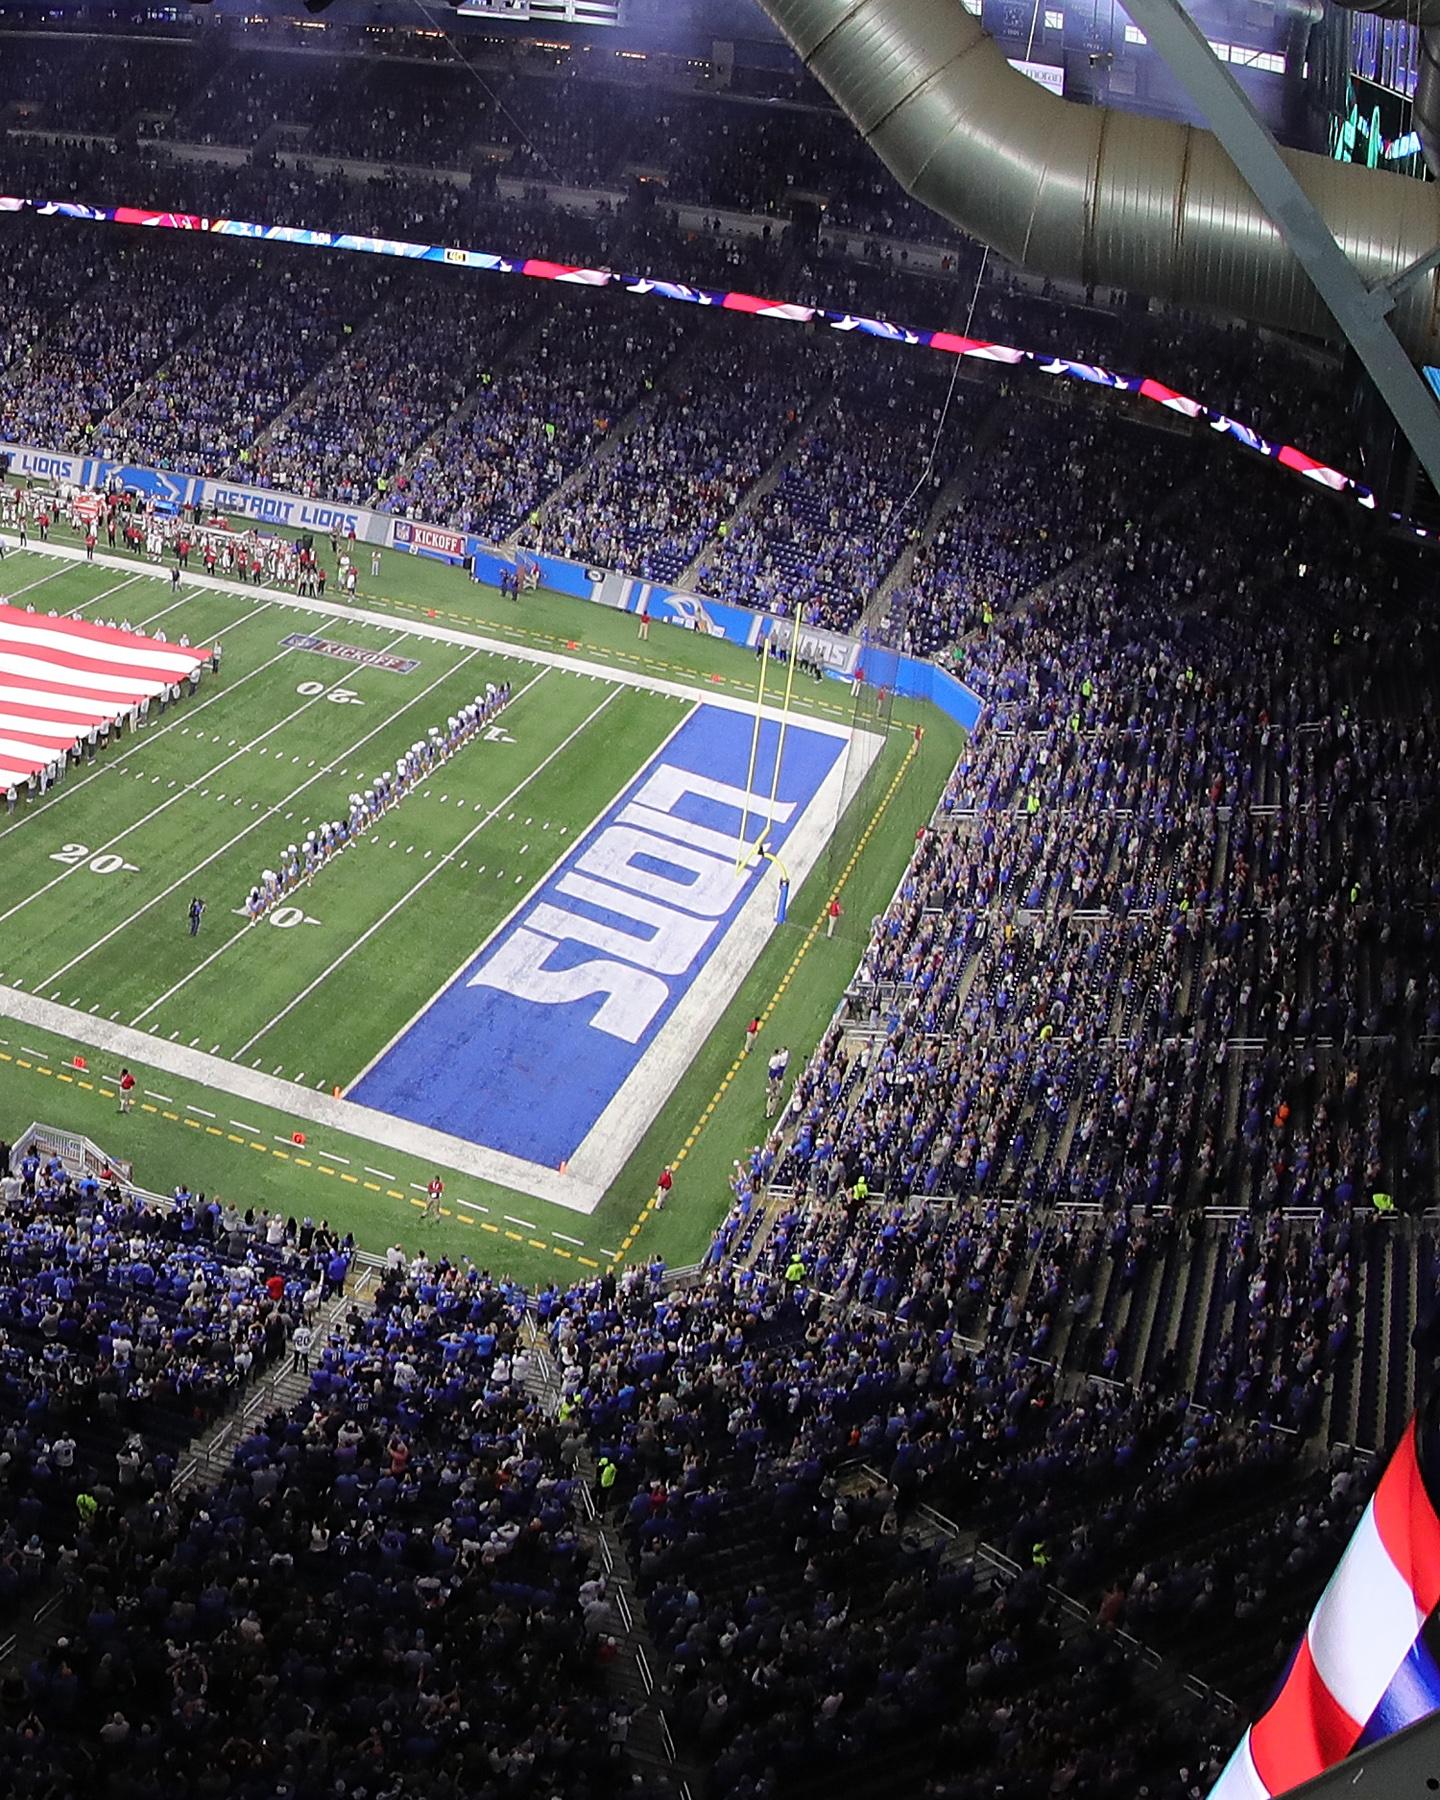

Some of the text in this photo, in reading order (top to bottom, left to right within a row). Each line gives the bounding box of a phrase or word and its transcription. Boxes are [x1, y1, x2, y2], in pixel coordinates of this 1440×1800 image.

[22, 454, 72, 477] LIONS
[214, 489, 358, 532] DETROIT LIONS
[415, 529, 458, 552] KICKOFF
[321, 642, 400, 667] KICKOFF
[466, 763, 798, 1044] LIONS
[296, 1336, 310, 1346] 20
